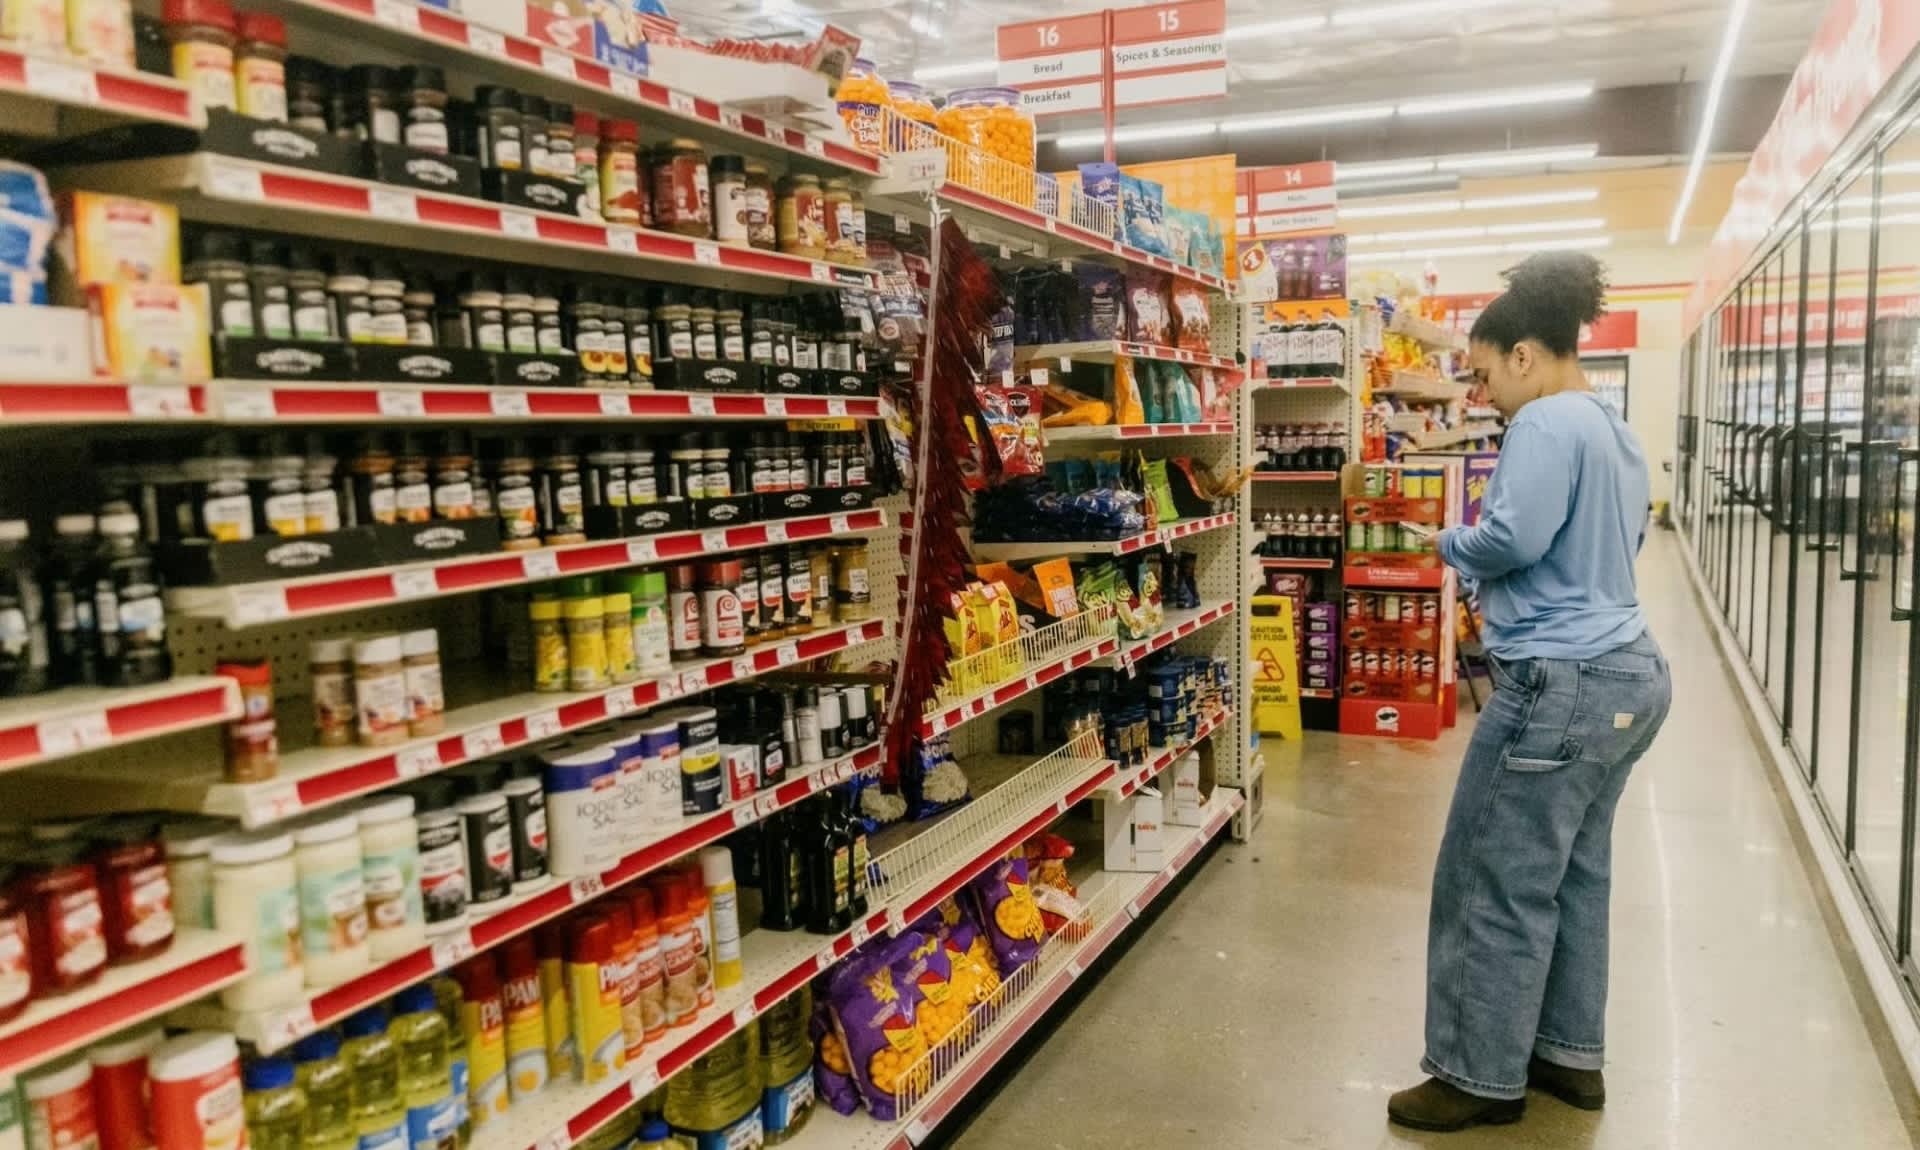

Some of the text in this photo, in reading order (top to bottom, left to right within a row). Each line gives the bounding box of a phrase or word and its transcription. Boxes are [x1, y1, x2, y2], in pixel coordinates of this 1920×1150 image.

[1157, 10, 1180, 32] 15
[1037, 26, 1060, 48] 16
[1115, 40, 1223, 64] Spices & Seasonings
[1033, 60, 1063, 75] Bread
[1024, 89, 1072, 104] Breakfast
[1284, 169, 1302, 185] 14
